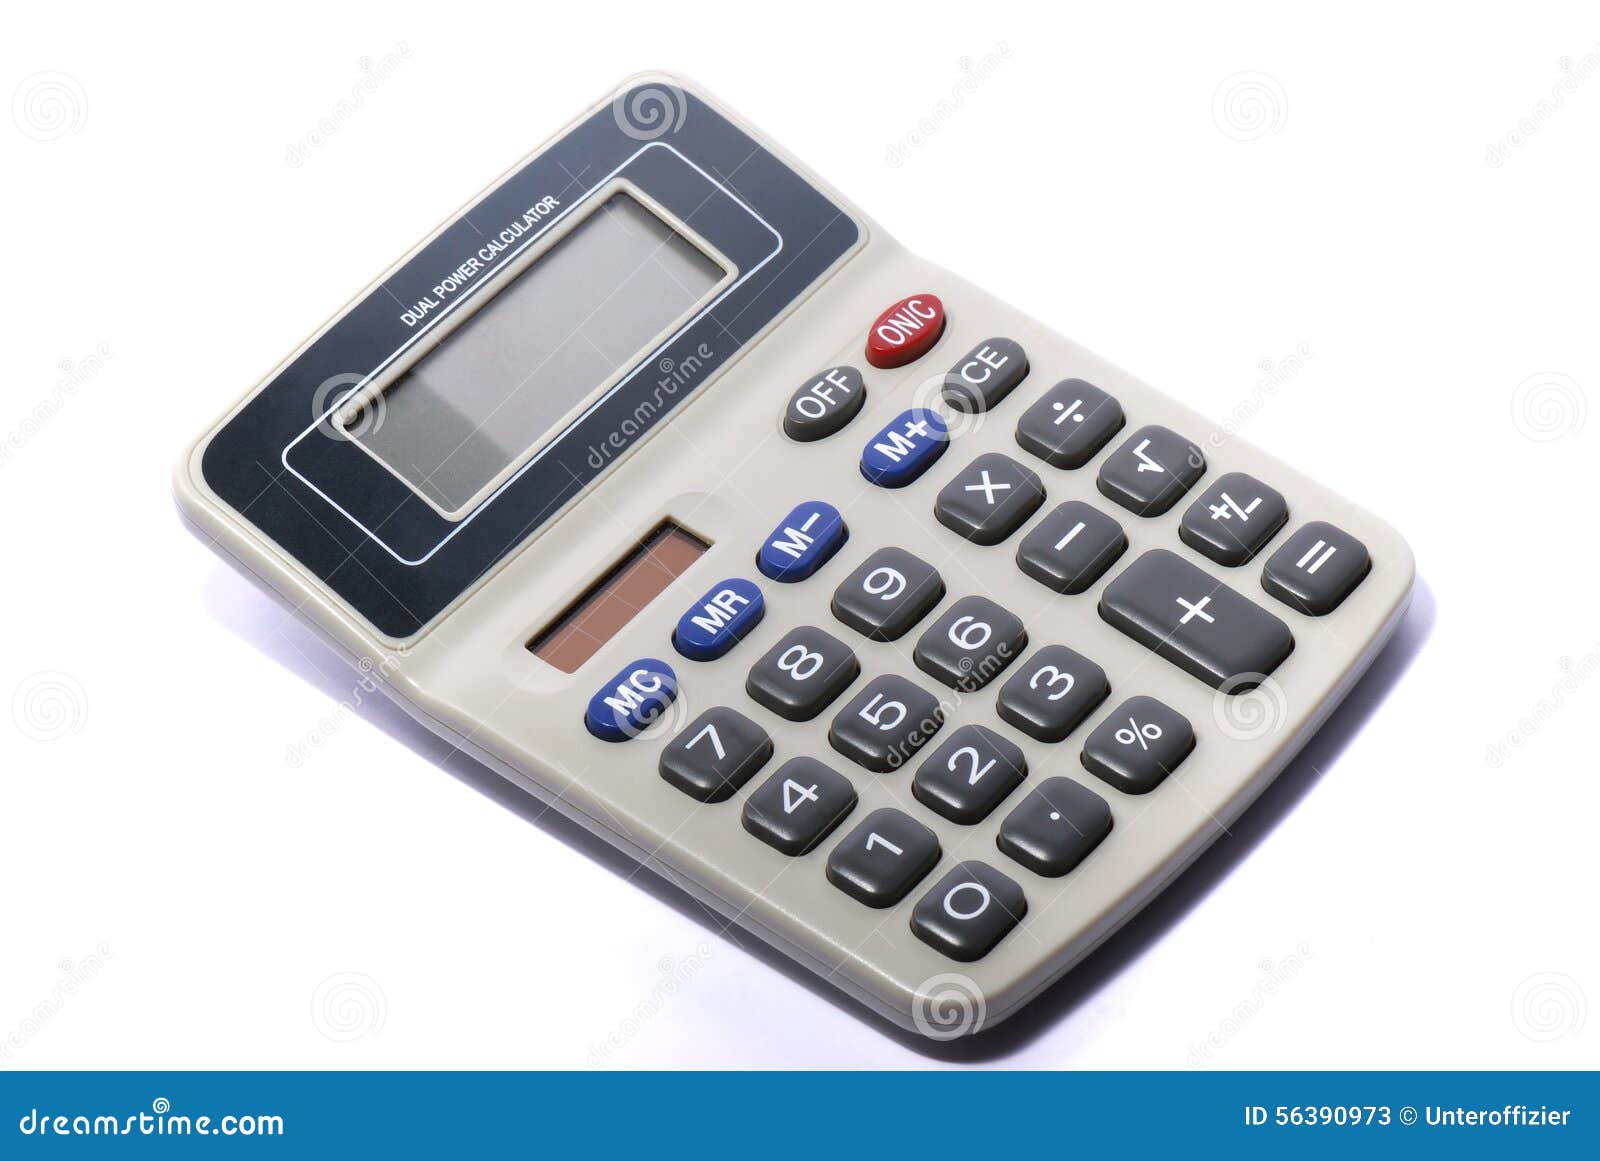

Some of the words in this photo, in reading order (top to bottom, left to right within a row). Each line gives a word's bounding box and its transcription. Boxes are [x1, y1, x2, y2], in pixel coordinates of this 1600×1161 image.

[400, 297, 440, 327] DUAL
[432, 257, 485, 299] POWER
[478, 195, 561, 262] CALCULATOR
[876, 299, 937, 346] ON/C
[960, 346, 1009, 385] CE
[795, 368, 853, 419] OFF
[873, 412, 929, 463] M+
[862, 566, 907, 601] 9
[690, 588, 750, 635] MR
[948, 615, 992, 650] 6
[777, 644, 824, 681] 8
[602, 667, 662, 717] MC
[1029, 665, 1075, 701] 3
[857, 692, 908, 731] 5
[685, 723, 727, 761] 7
[1115, 717, 1162, 751] %
[947, 746, 997, 786] 2
[783, 778, 819, 814] 4
[866, 832, 904, 856] 1
